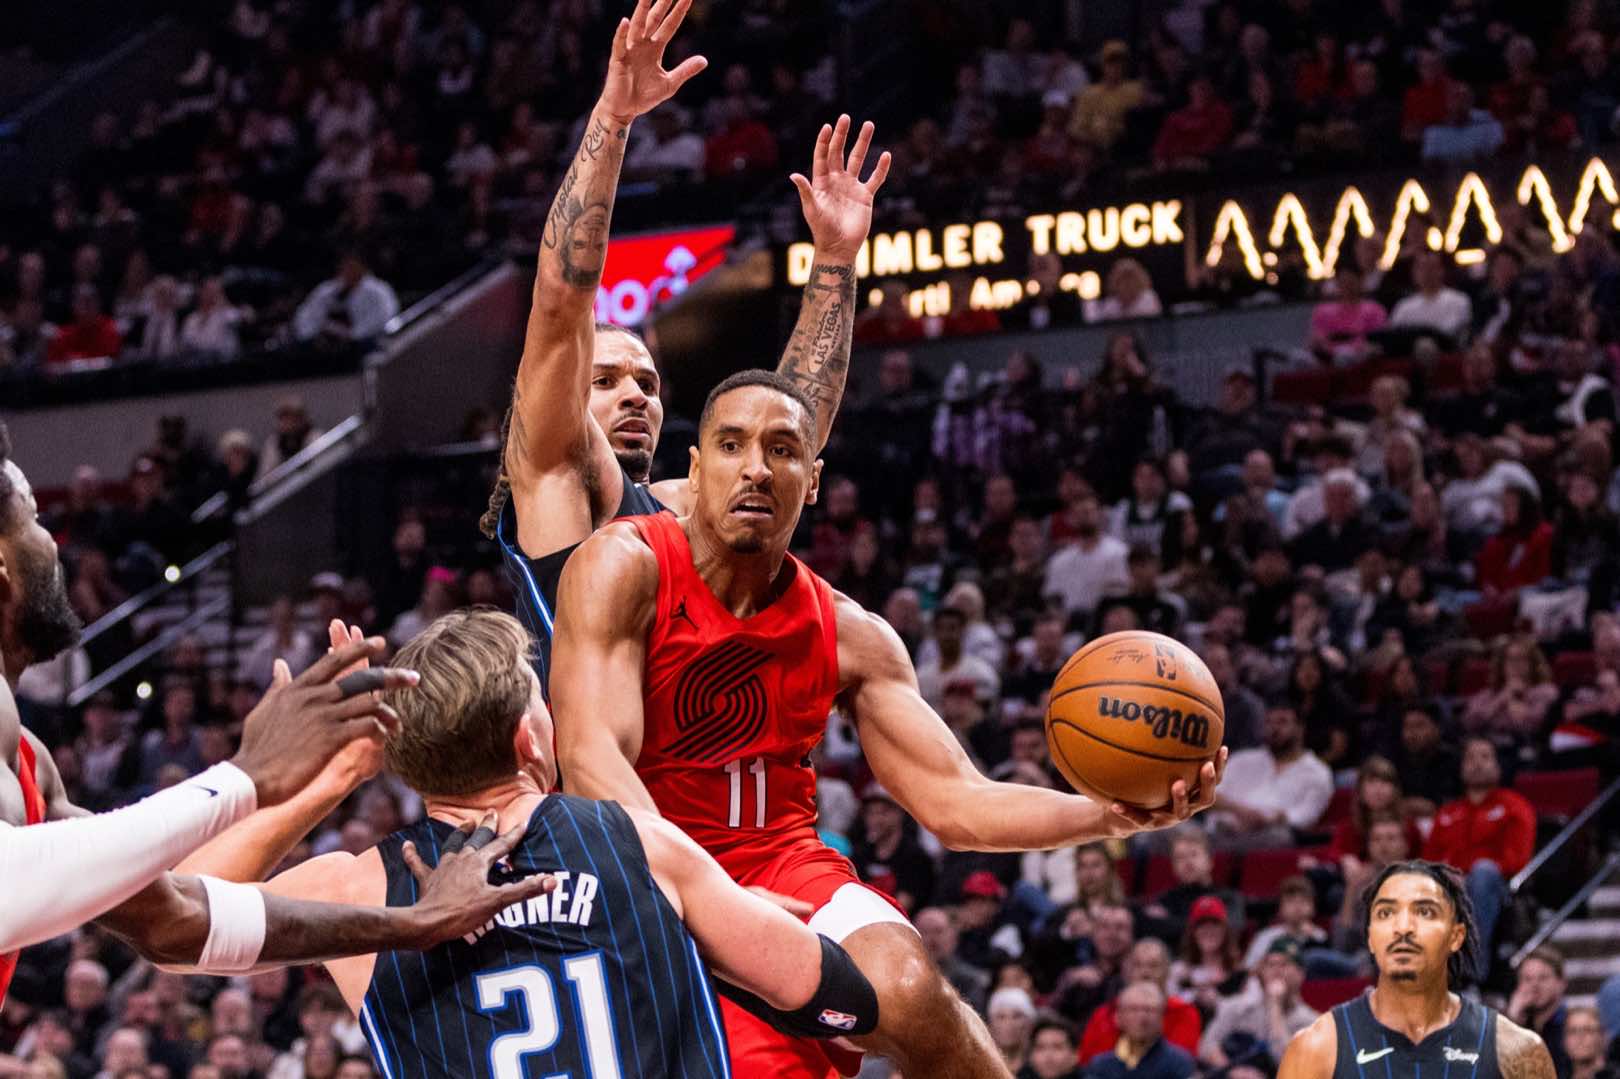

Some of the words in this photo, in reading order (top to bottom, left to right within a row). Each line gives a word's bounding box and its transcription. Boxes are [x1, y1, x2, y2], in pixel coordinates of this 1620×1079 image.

[787, 220, 1005, 287] DIMLER
[1025, 199, 1184, 257] TRUCK
[814, 344, 829, 365] LAS
[821, 302, 841, 340] VEGAS
[1098, 696, 1210, 749] Wilson
[724, 757, 766, 829] 11
[463, 871, 599, 945] GNER
[472, 951, 624, 1079] 21
